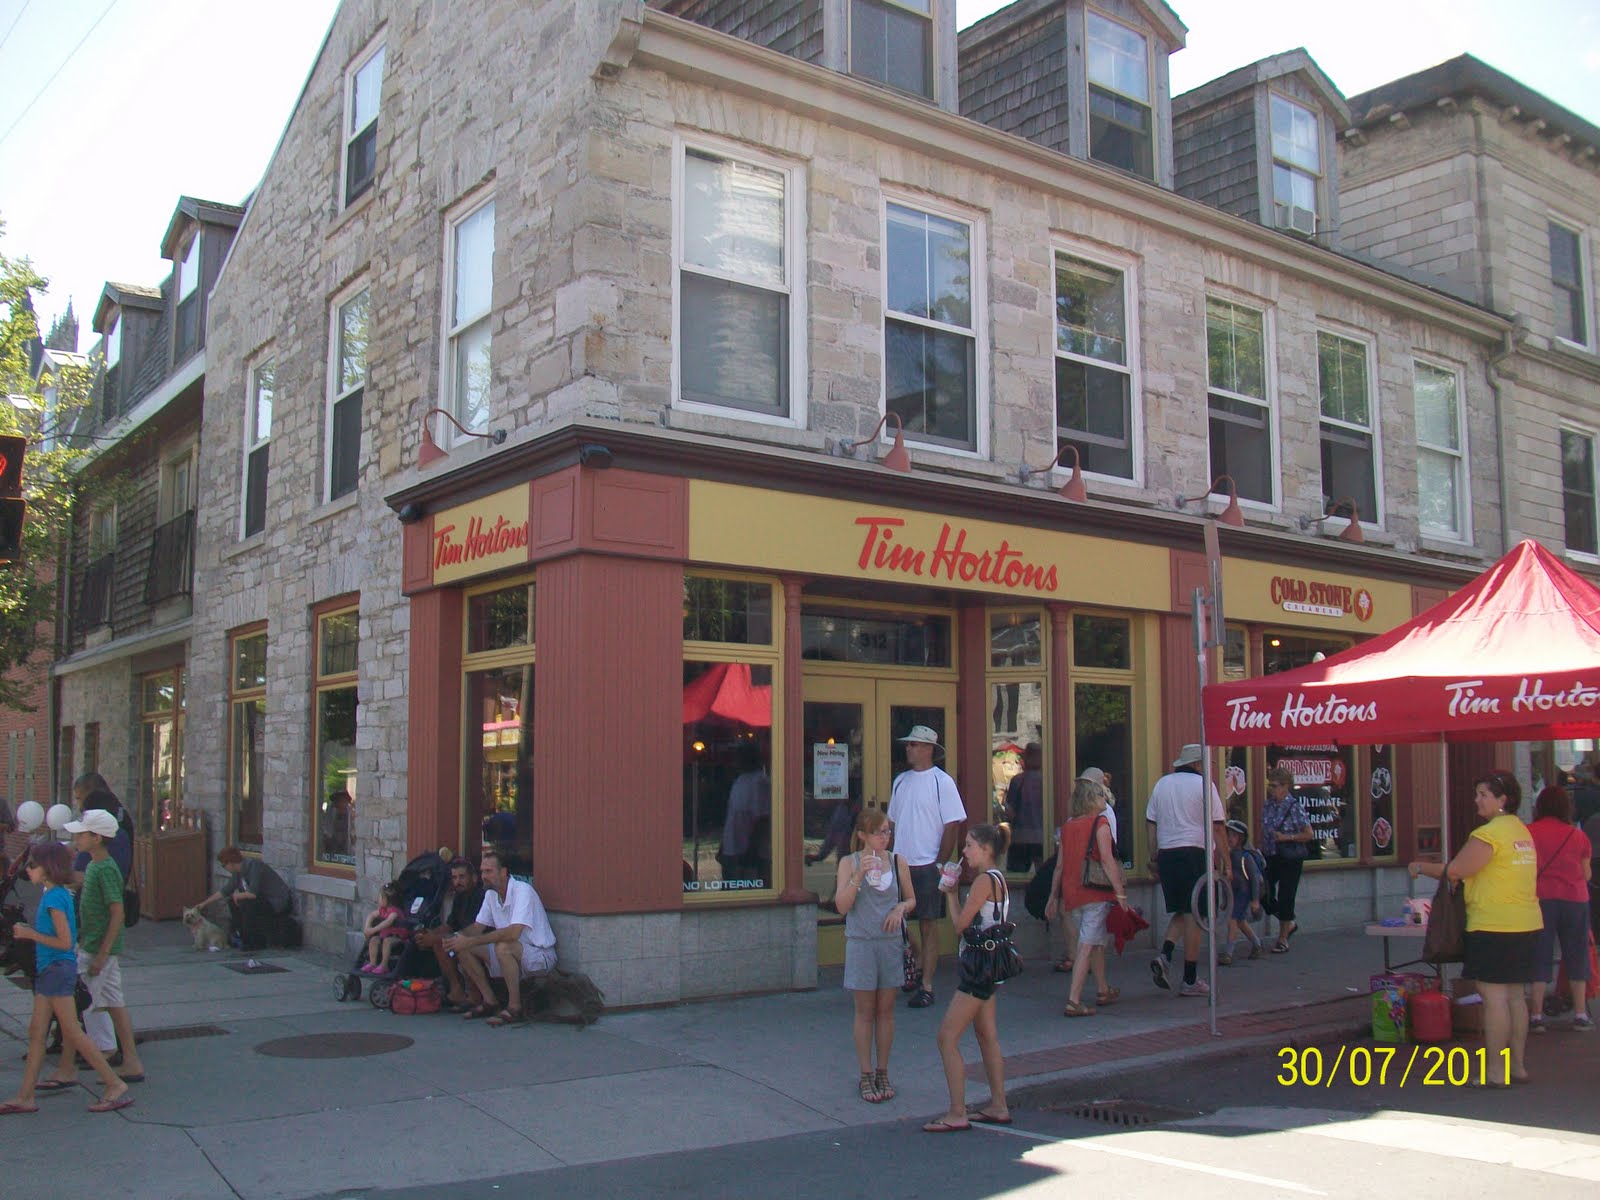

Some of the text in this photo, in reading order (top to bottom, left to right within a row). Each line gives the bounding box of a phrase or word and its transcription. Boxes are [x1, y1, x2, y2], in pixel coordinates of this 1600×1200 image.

[434, 515, 528, 570] Tim Hortons
[855, 517, 1058, 592] Tim Hortons
[1271, 576, 1353, 613] COLD STONE
[1287, 604, 1340, 615] CREAMERY
[1445, 677, 1600, 717] Tim Horto
[1226, 693, 1377, 731] Tim Hortons
[1301, 760, 1332, 780] STONE
[1299, 796, 1341, 808] ULTIMATE
[1310, 813, 1334, 823] REAM
[683, 879, 764, 890] NO LOITERING
